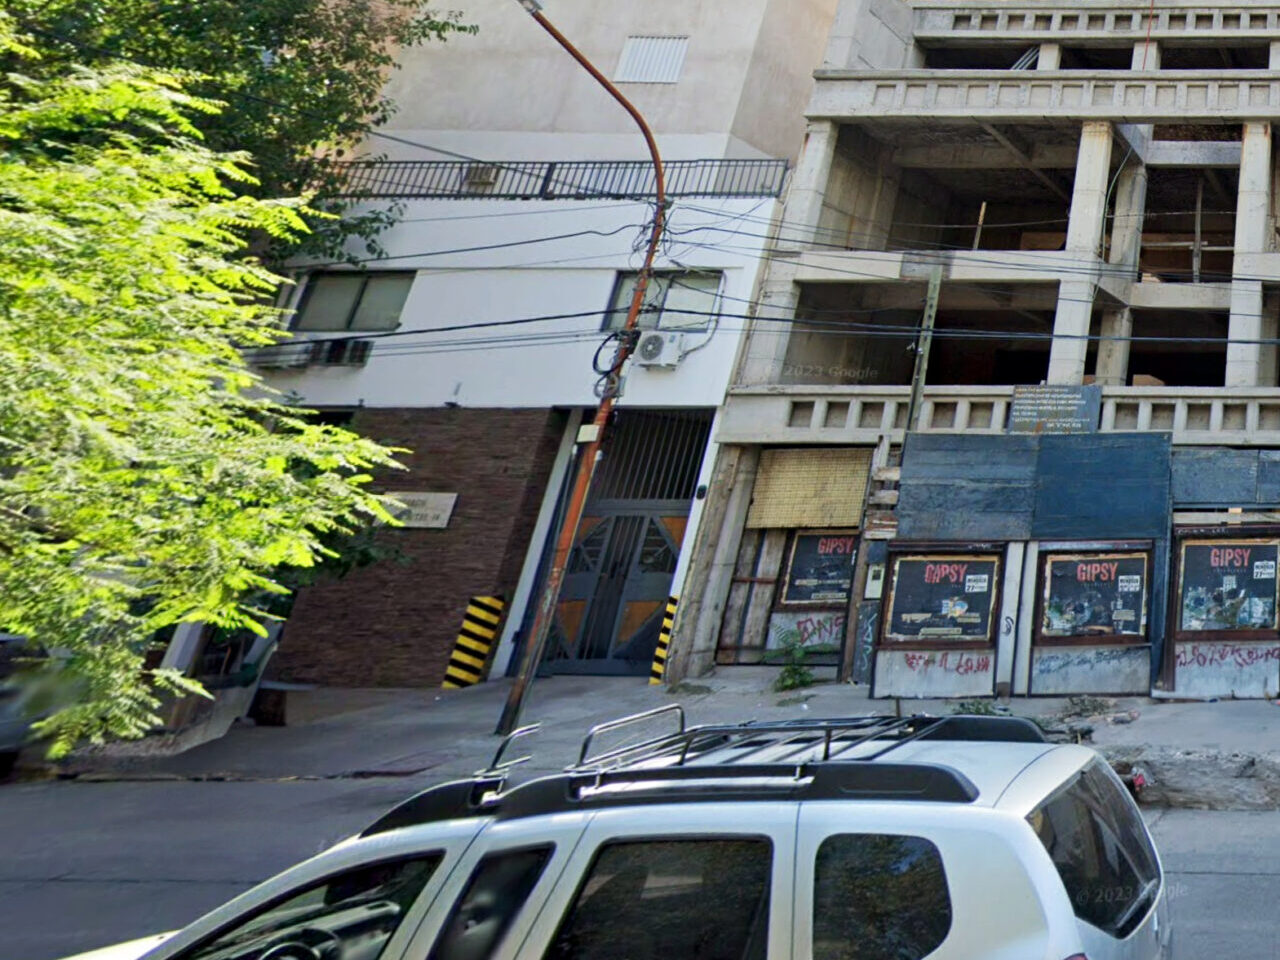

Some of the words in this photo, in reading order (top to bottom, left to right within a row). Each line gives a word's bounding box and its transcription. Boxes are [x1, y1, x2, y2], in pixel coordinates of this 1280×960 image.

[817, 537, 854, 554] GIPSY
[1209, 548, 1251, 568] GIPSY
[924, 563, 968, 584] GIPSY
[1077, 562, 1119, 582] GIPSY
